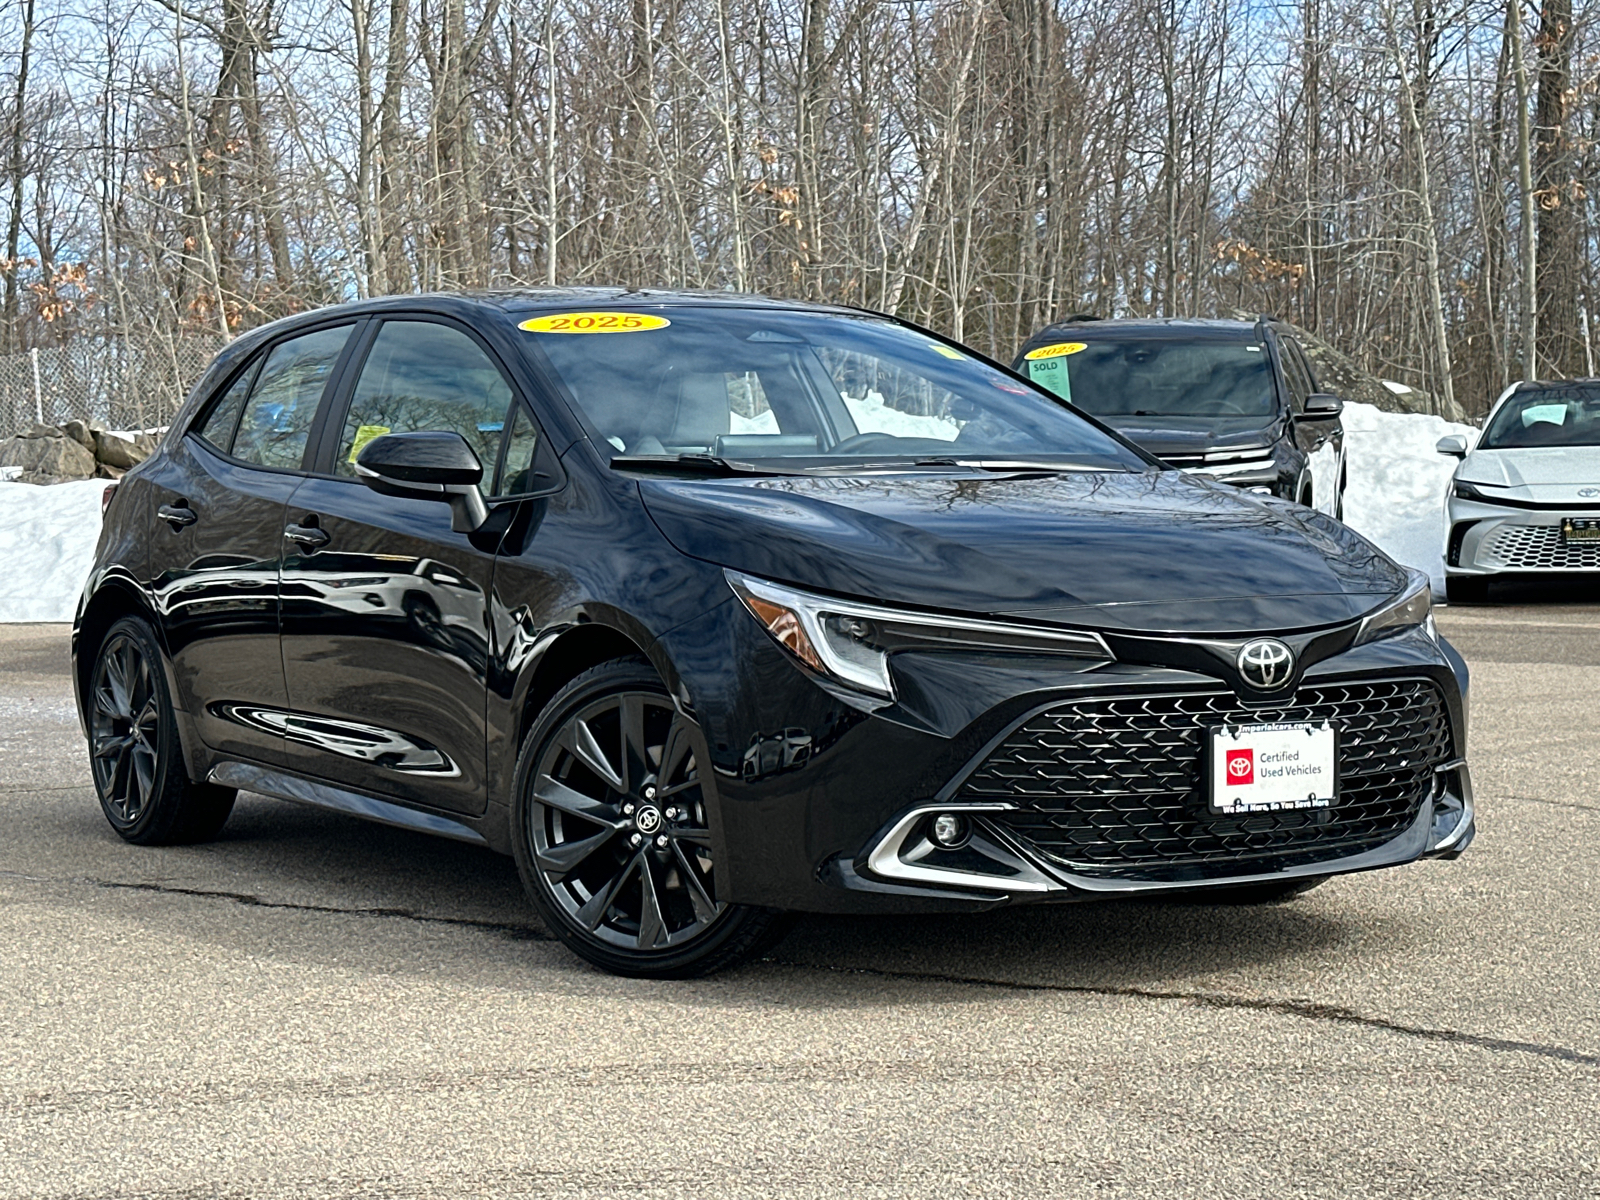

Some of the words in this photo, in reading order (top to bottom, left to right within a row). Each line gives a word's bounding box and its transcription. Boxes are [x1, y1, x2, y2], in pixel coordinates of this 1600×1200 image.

[550, 316, 643, 330] 2025
[1036, 344, 1076, 358] 2025
[1033, 362, 1058, 372] SOLD
[1260, 750, 1299, 763] Certified
[1260, 766, 1283, 778] Used
[1285, 764, 1322, 776] Vehicles
